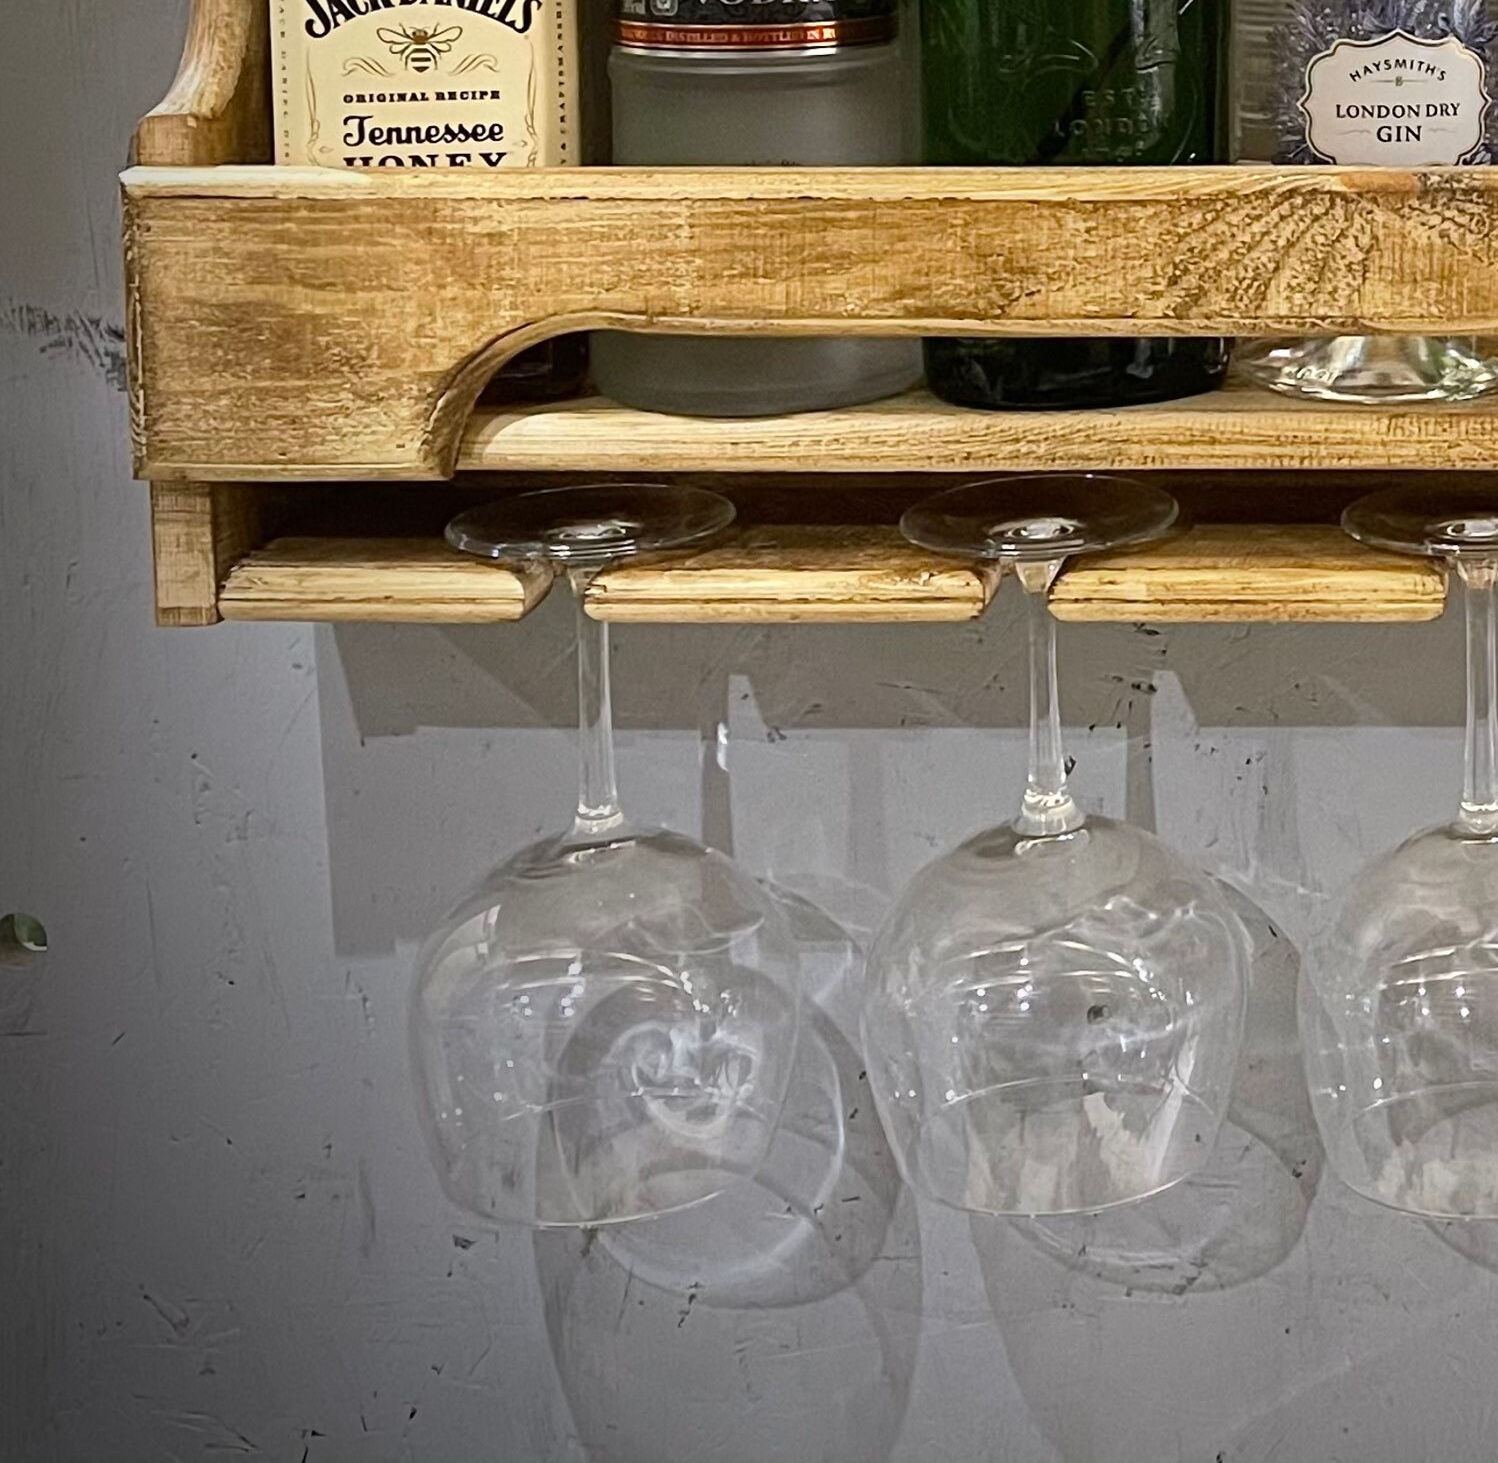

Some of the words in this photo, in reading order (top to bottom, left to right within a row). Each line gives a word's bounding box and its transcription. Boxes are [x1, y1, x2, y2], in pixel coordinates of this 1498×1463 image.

[1349, 58, 1447, 82] HAYSMITH'S
[343, 92, 429, 104] ORIGINAL
[435, 90, 500, 101] RECIPE
[1336, 103, 1420, 119] LONDON
[1425, 102, 1460, 118] DRY
[343, 115, 504, 147] Tennessee
[1376, 125, 1422, 143] GIN
